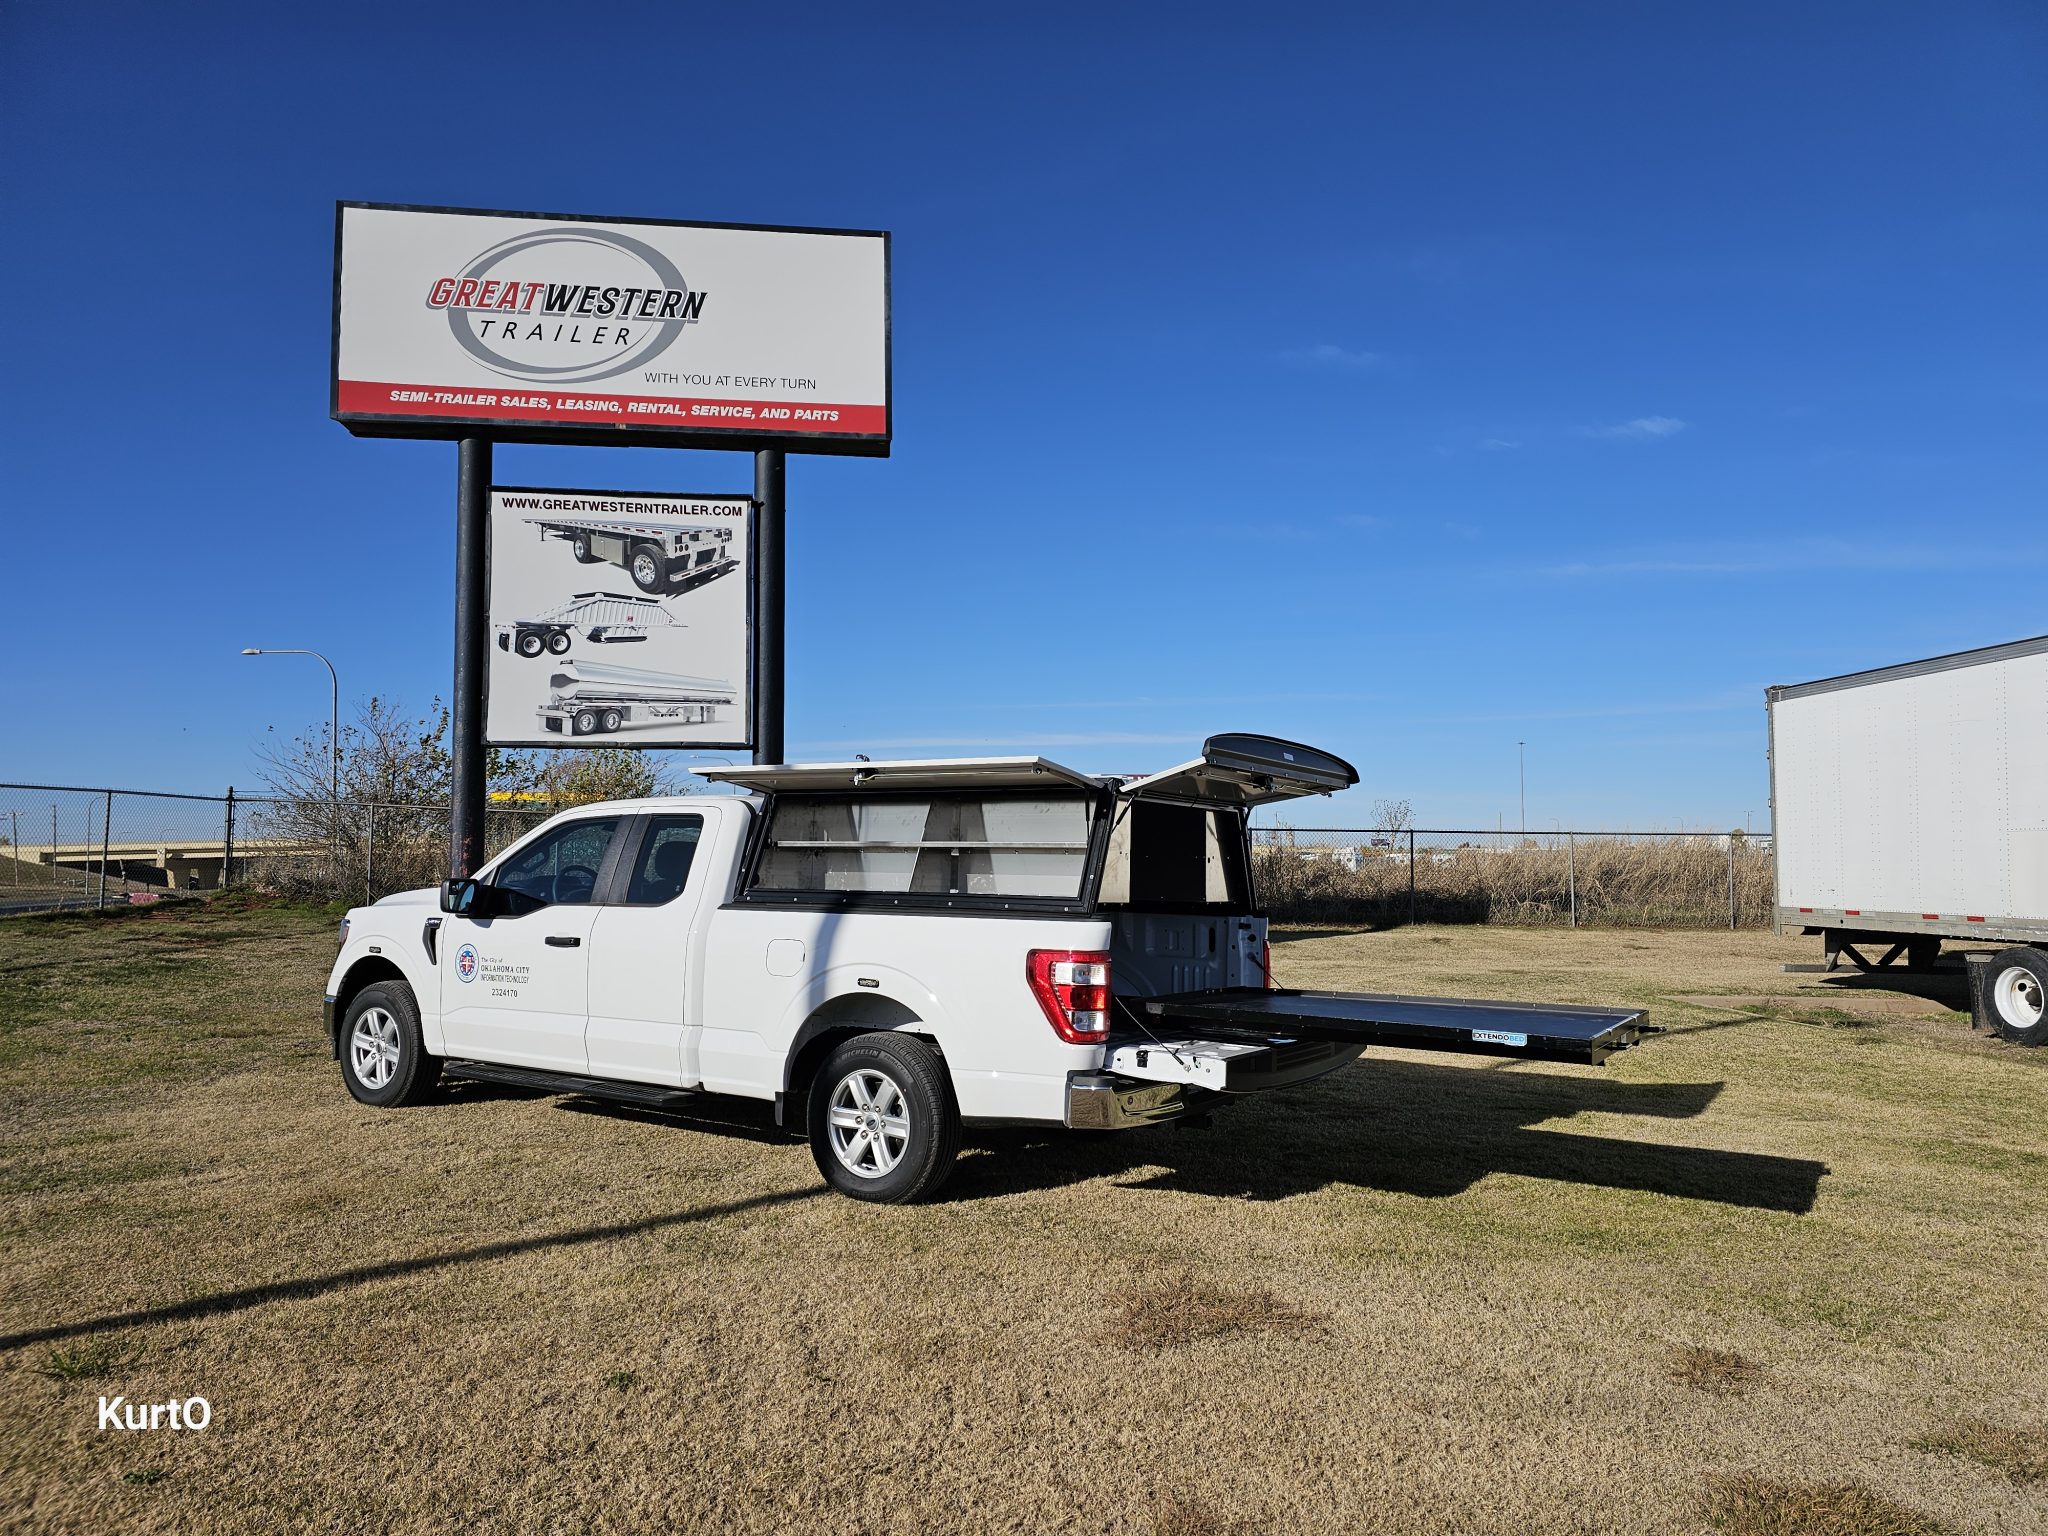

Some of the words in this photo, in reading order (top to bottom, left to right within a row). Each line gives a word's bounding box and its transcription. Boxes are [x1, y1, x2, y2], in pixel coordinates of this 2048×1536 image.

[480, 320, 630, 346] TRAILER
[644, 372, 679, 384] WITH
[683, 374, 712, 386] YOU
[715, 375, 731, 386] AT
[734, 376, 777, 389] EVERY
[780, 377, 817, 390] TURN
[389, 390, 498, 406] SEMI-TRAILER
[500, 396, 552, 411] SALES,
[555, 398, 623, 414] LEASING,
[627, 402, 687, 417] RENTAL,
[690, 405, 756, 420] SERVICE,
[759, 407, 791, 419] AND
[794, 409, 840, 421] PARTS
[501, 497, 743, 517] WWW.GREATWESTERNTRAILER.COM
[481, 965, 514, 973] OKLAHOMA
[516, 966, 530, 974] CITY
[492, 988, 518, 997] 2324170
[1472, 1033, 1525, 1041] EXTENDOBED
[841, 1049, 879, 1060] MICHELIN
